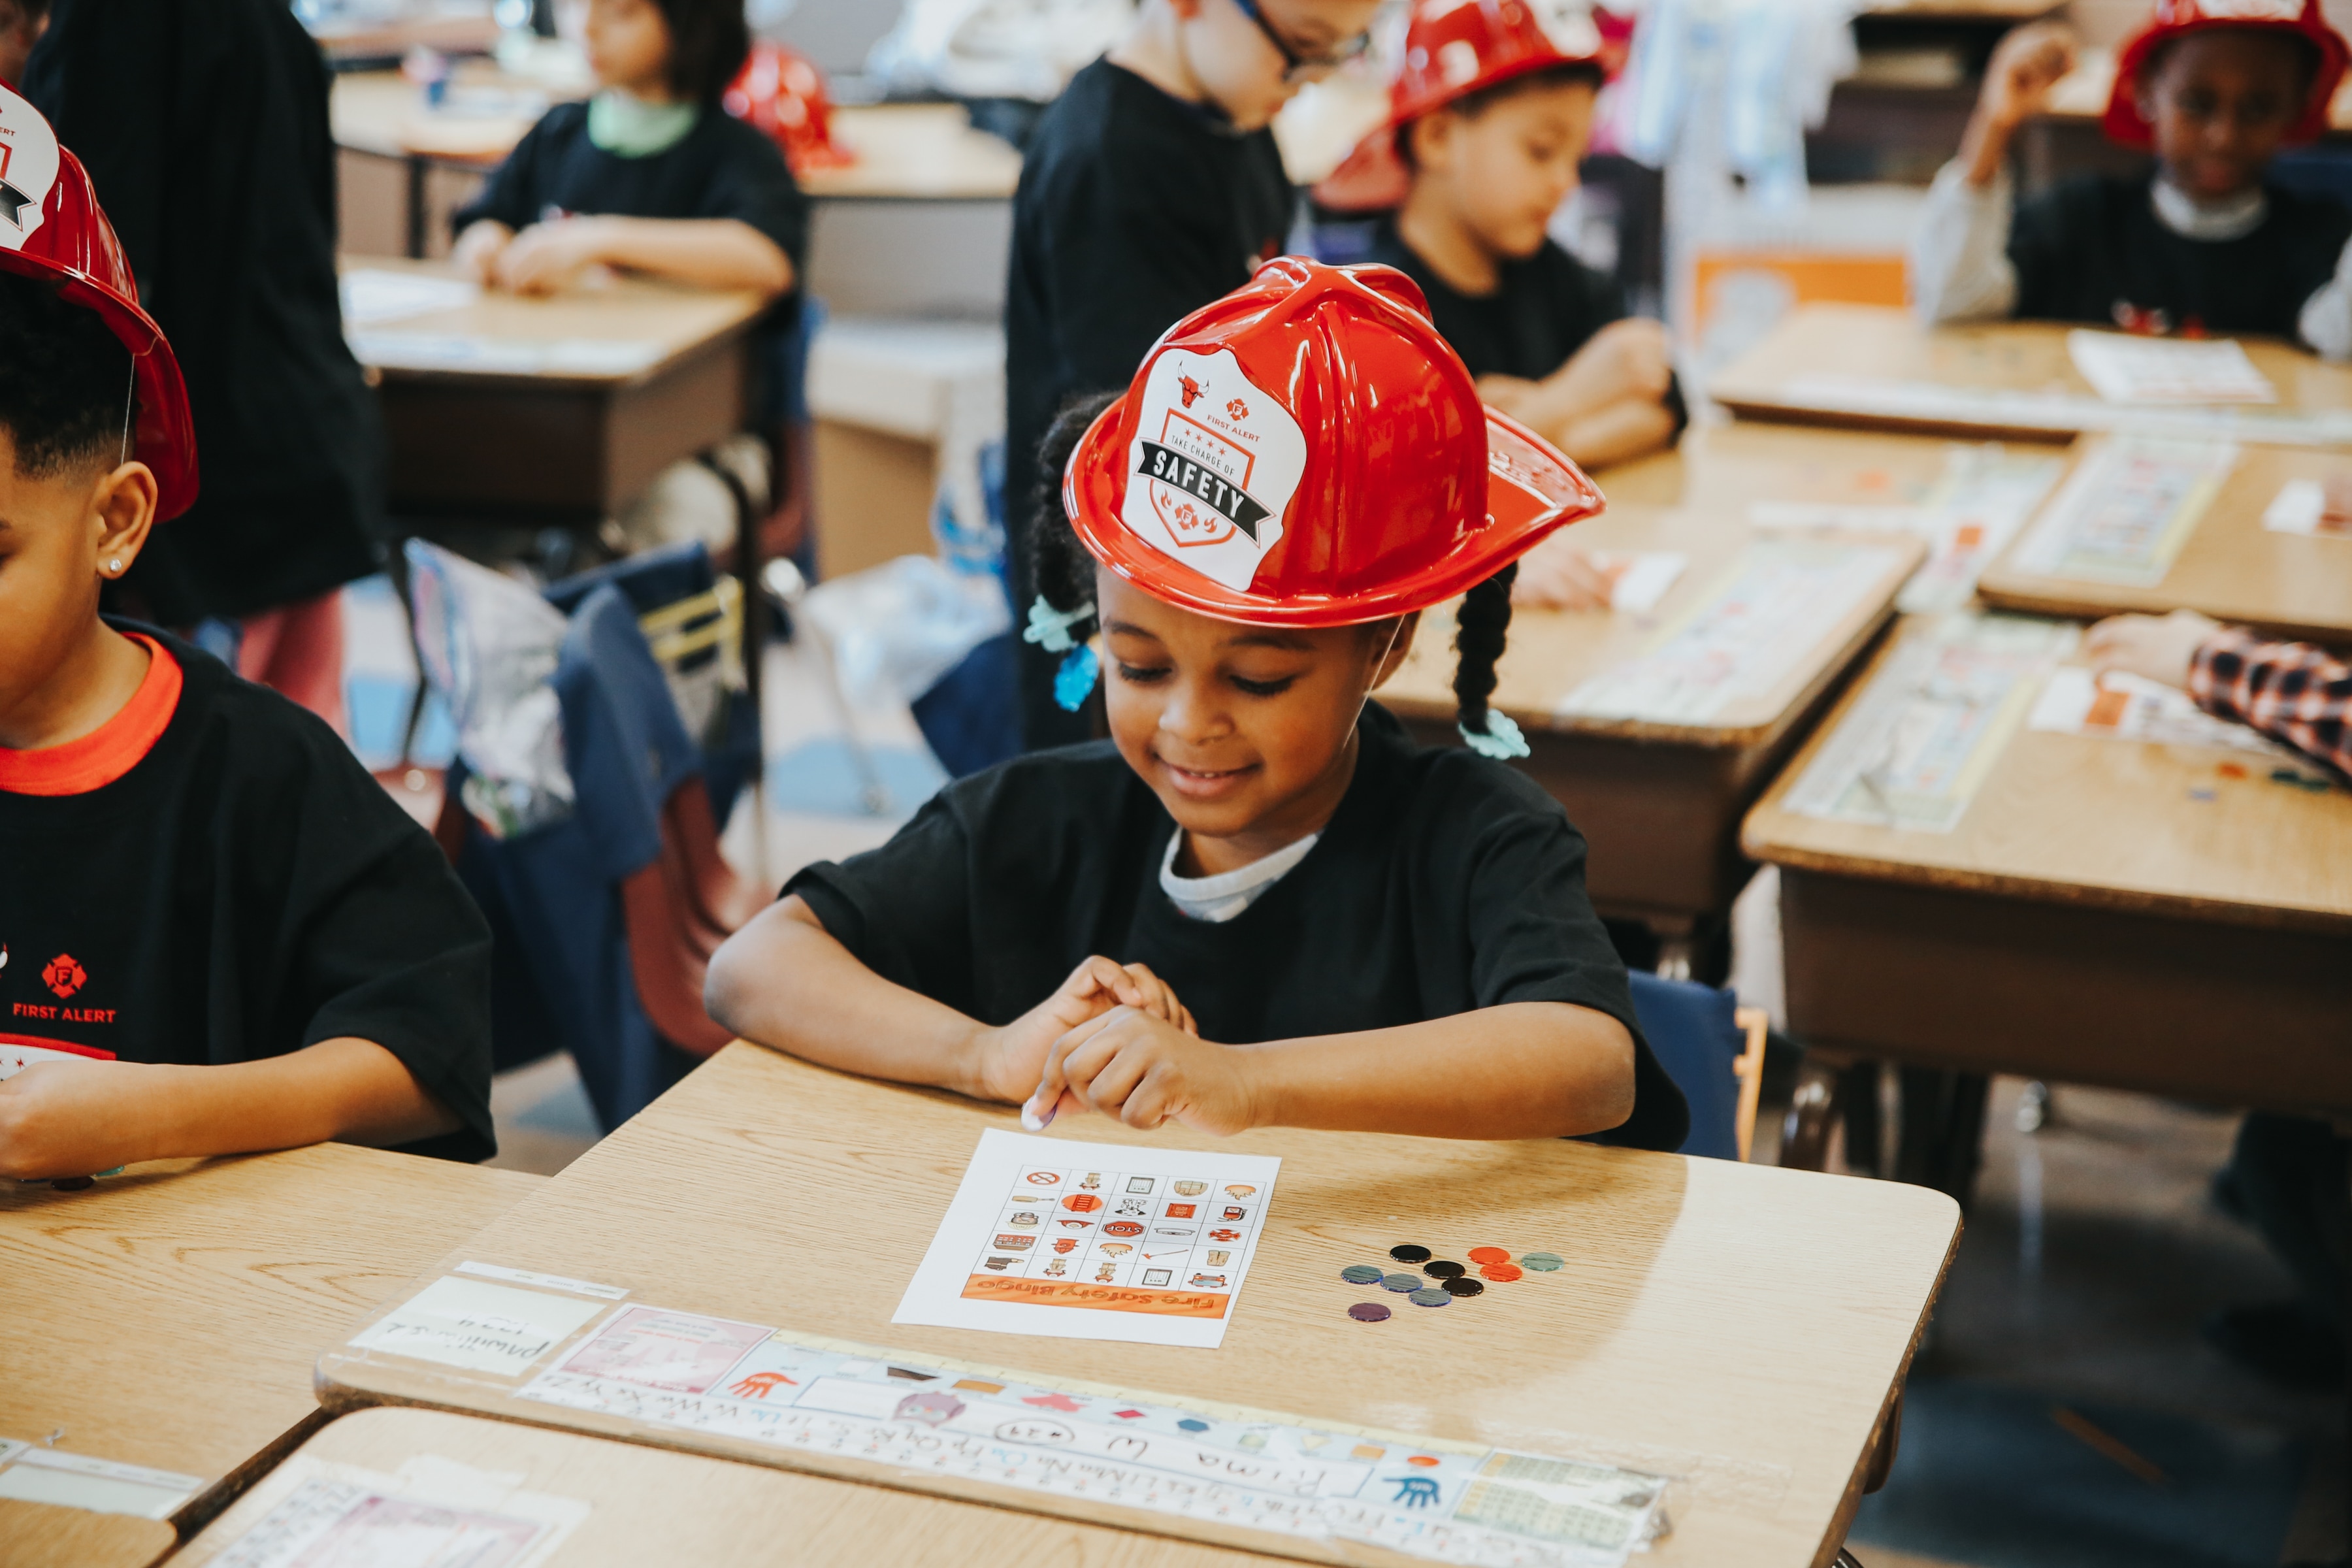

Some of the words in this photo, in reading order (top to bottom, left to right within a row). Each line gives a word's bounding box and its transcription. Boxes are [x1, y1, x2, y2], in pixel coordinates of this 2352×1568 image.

[1207, 414, 1230, 430] FIRST
[1232, 427, 1260, 442] ALERT
[1171, 434, 1188, 449] TAKE
[1190, 444, 1221, 468] CHARGE
[1224, 465, 1235, 476] OF
[1153, 449, 1245, 519] SAFETY
[57, 969, 71, 985] F
[13, 1002, 57, 1019] FIRST
[61, 1007, 116, 1023] ALERT
[1106, 1224, 1142, 1235] STOP
[977, 1279, 1054, 1297] Bingo
[1061, 1285, 1152, 1305] Safety
[1160, 1295, 1215, 1310] Fire
